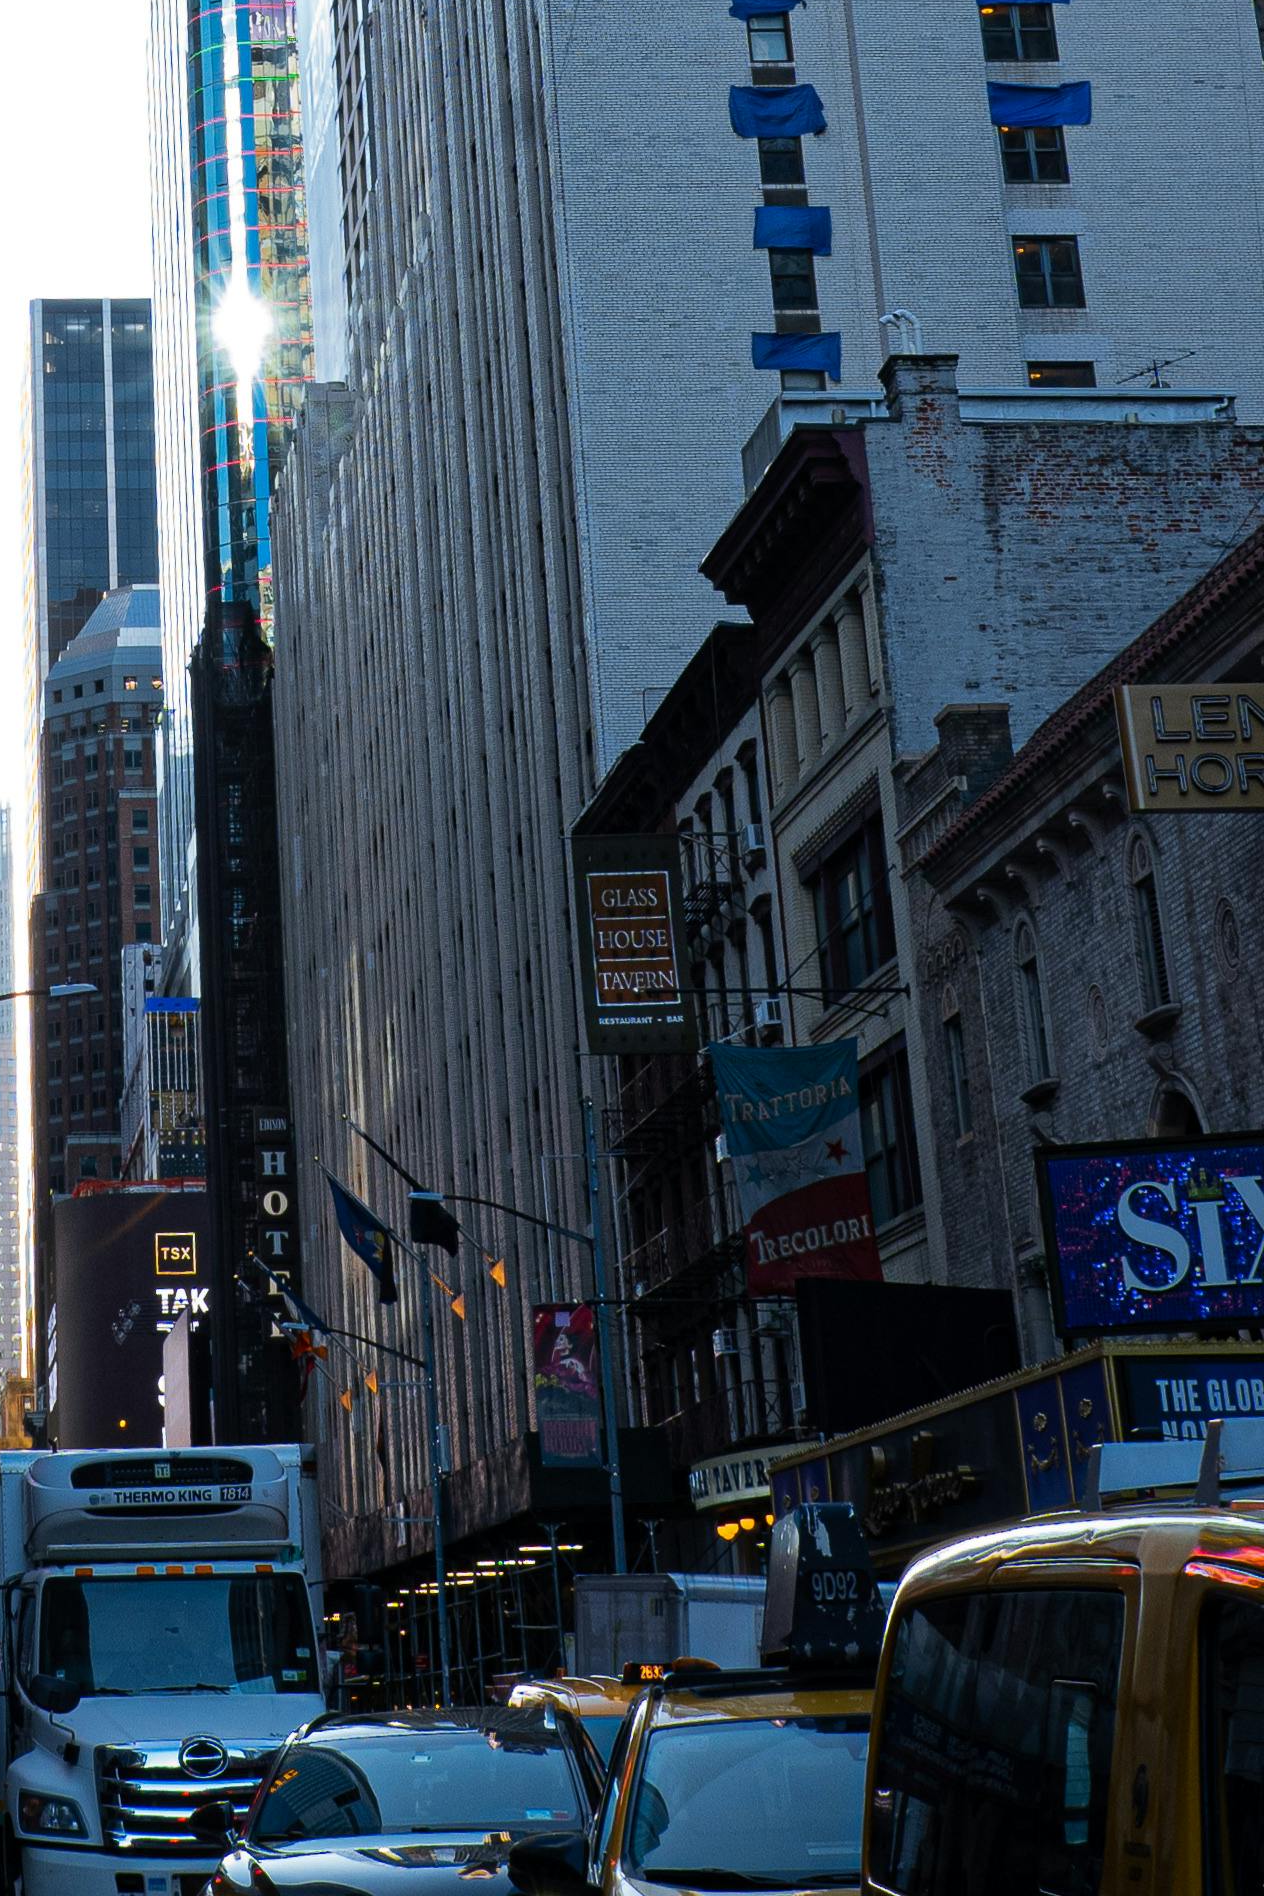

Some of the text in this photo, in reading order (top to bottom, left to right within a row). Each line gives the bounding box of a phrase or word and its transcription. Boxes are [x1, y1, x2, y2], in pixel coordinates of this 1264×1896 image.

[1151, 695, 1264, 742] LEN
[601, 888, 658, 908] GLASS
[598, 929, 668, 949] HOUSE
[599, 969, 675, 991] TAVERN
[599, 1016, 653, 1025] RESTAURANT
[724, 1075, 852, 1123] TRATTORIA
[750, 1214, 872, 1265] TRECOLORI
[161, 1247, 191, 1261] TSX
[1155, 1378, 1202, 1412] THE
[1161, 1420, 1208, 1440] NO
[713, 1456, 783, 1494] TAVER
[114, 1489, 212, 1504] THERMO KING
[221, 1487, 250, 1501] 1814
[811, 1571, 858, 1601] 9D92
